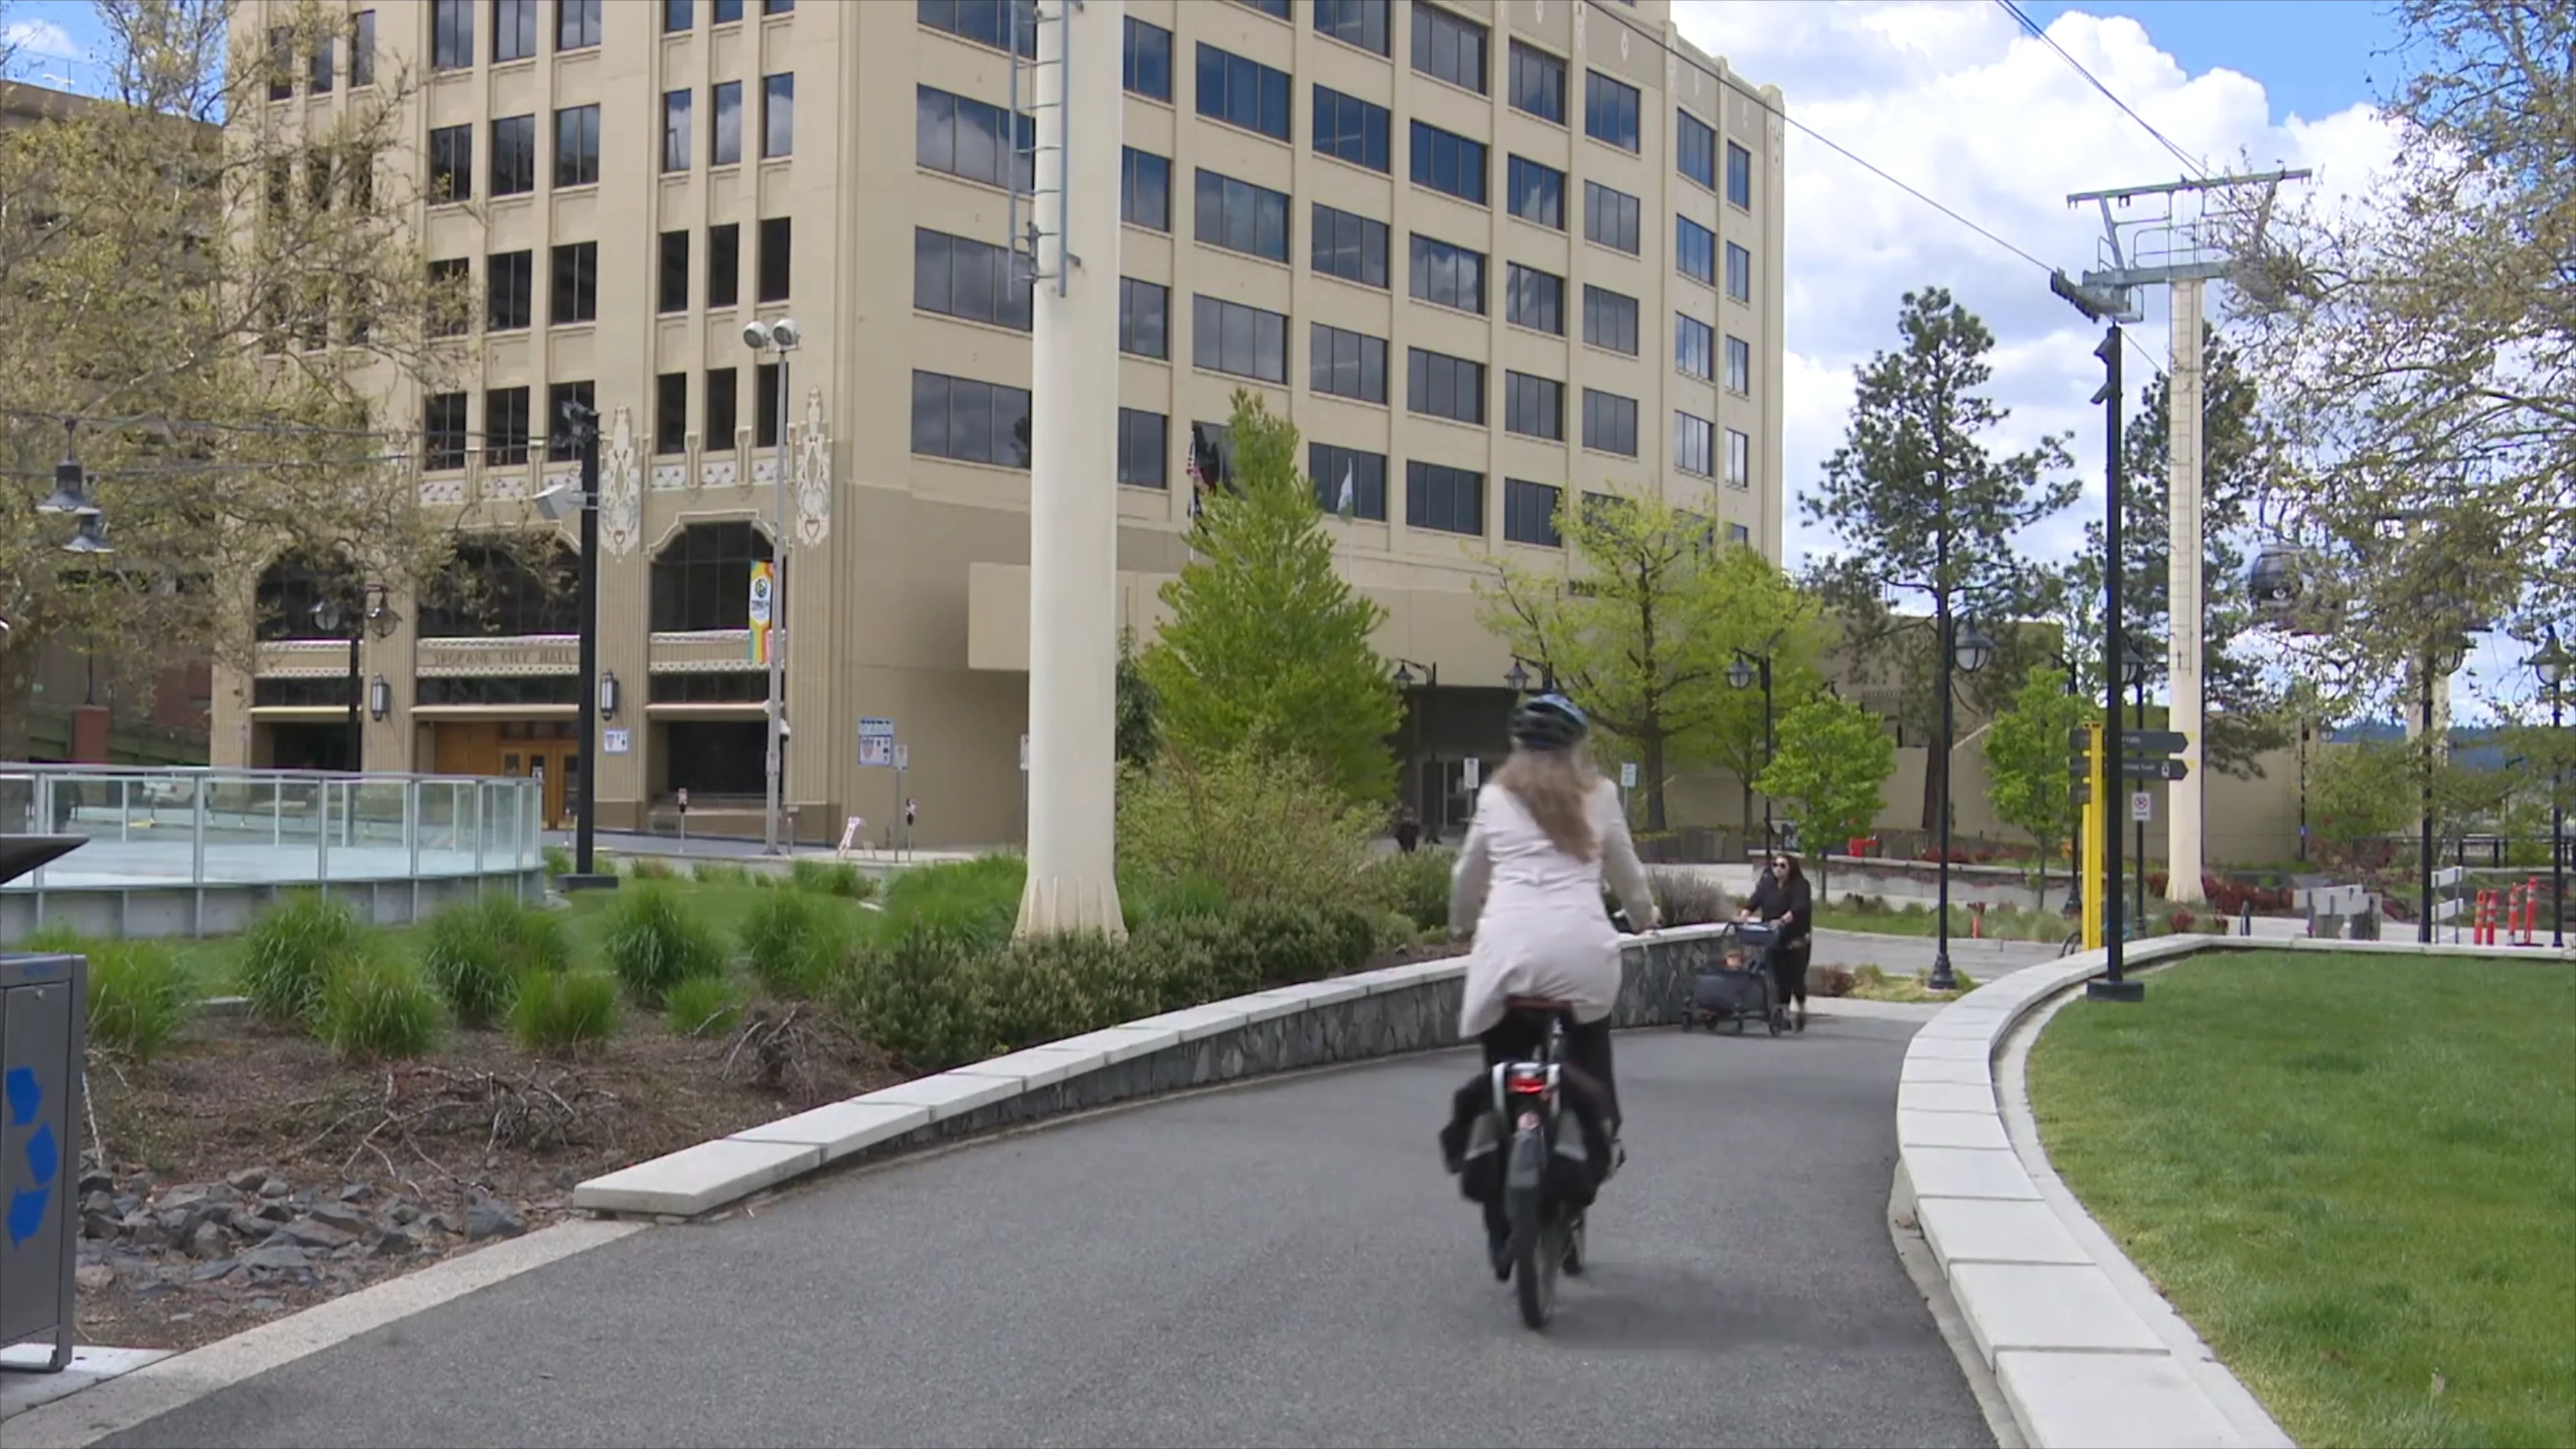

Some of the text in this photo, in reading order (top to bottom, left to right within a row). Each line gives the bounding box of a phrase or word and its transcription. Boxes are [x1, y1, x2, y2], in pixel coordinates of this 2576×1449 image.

[433, 648, 572, 664] SPOKANE CITY HALL
